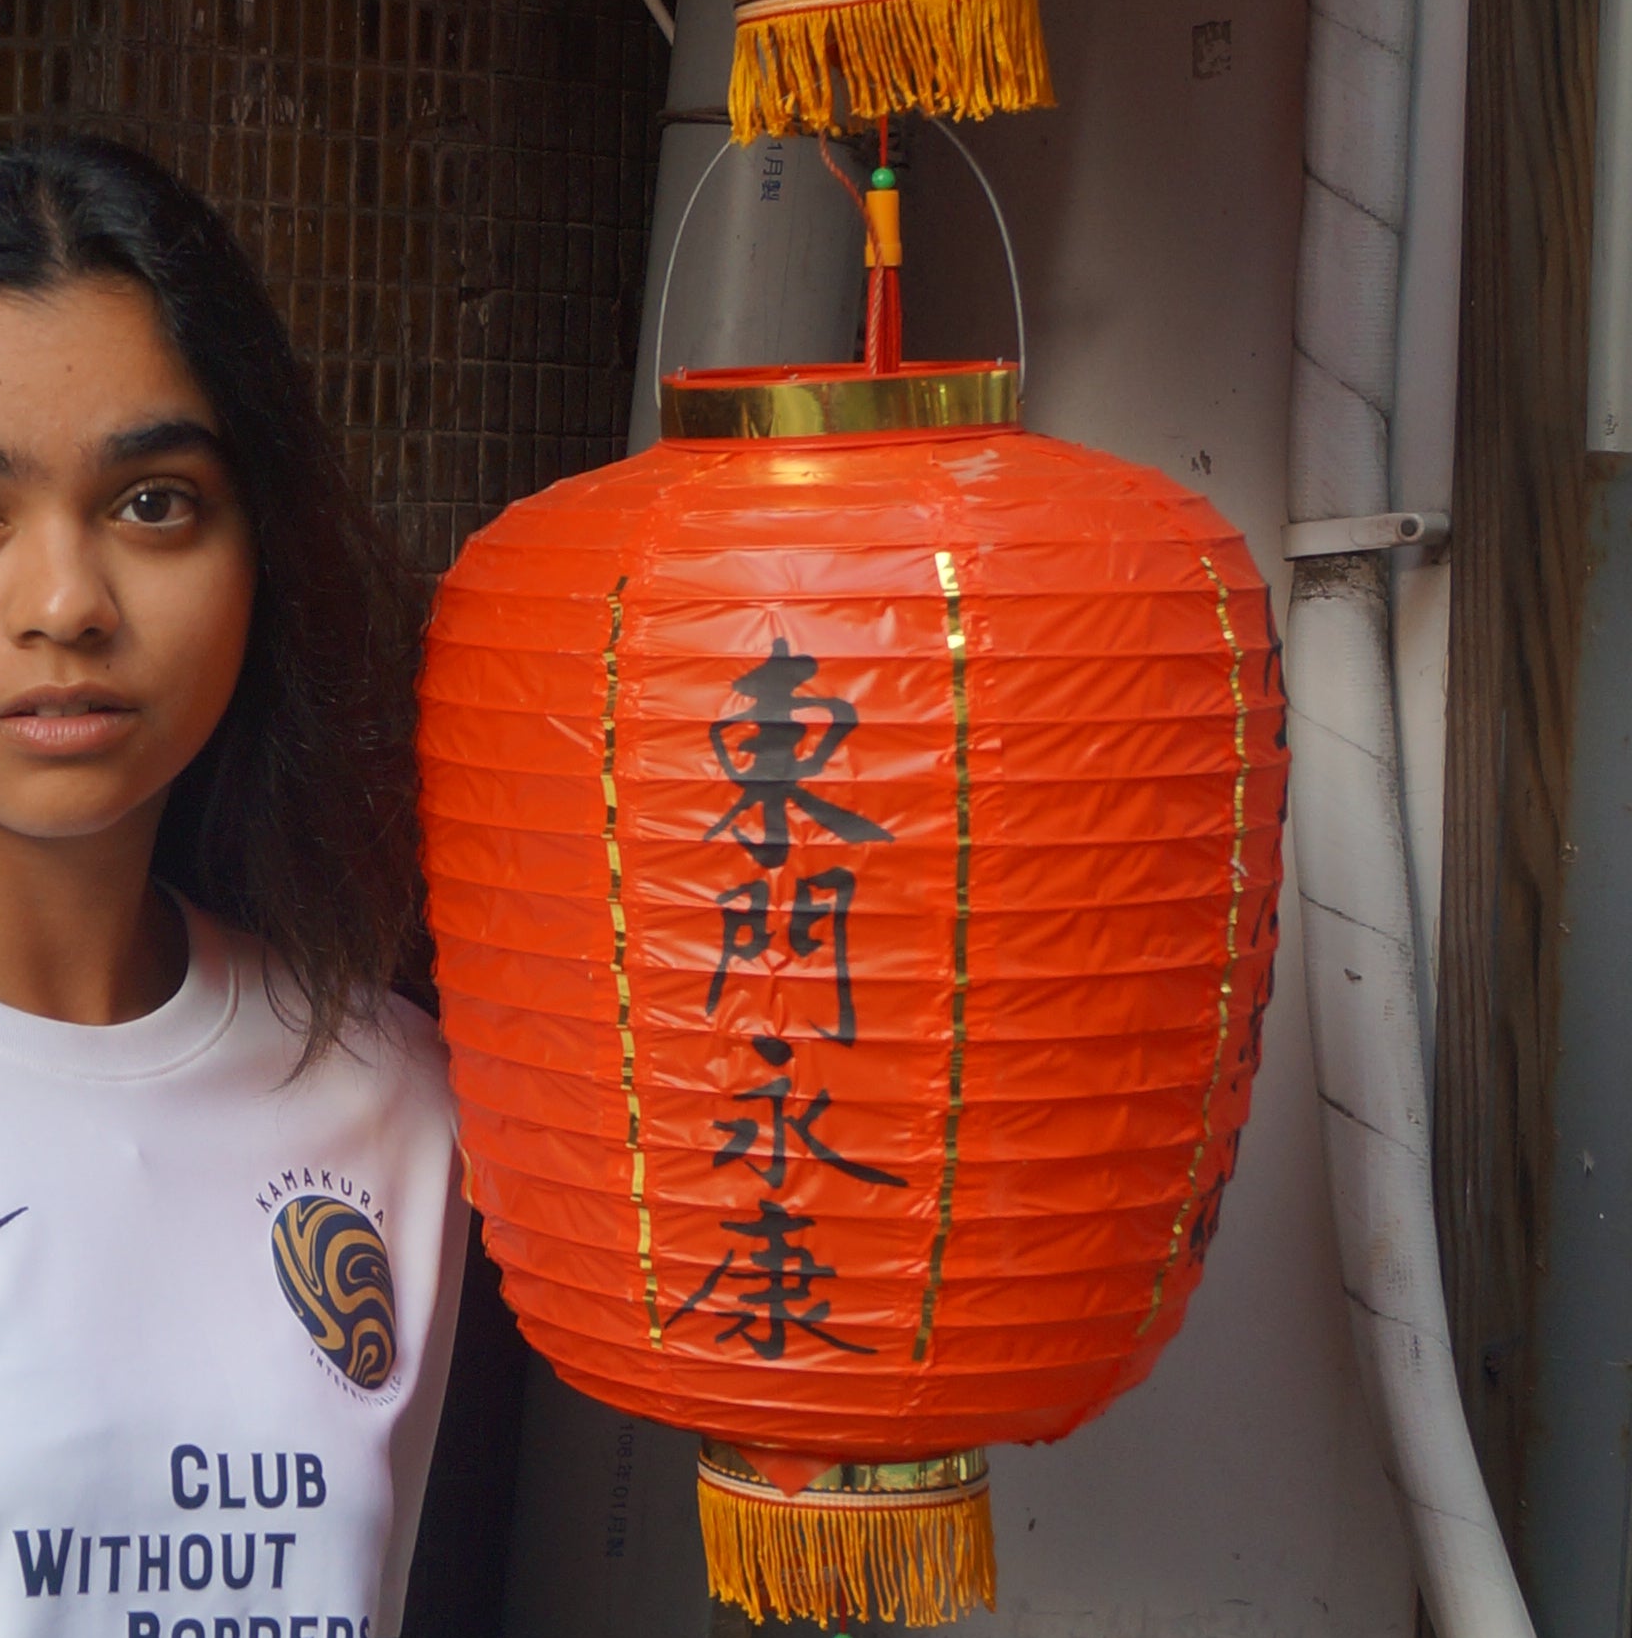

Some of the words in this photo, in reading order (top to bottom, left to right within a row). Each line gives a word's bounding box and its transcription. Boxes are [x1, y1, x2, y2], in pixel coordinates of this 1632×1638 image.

[664, 638, 909, 1361] 東門永康
[256, 1167, 385, 1228] KAMAKURA
[170, 1443, 327, 1510] CLUB
[13, 1527, 296, 1598] WITHOUT
